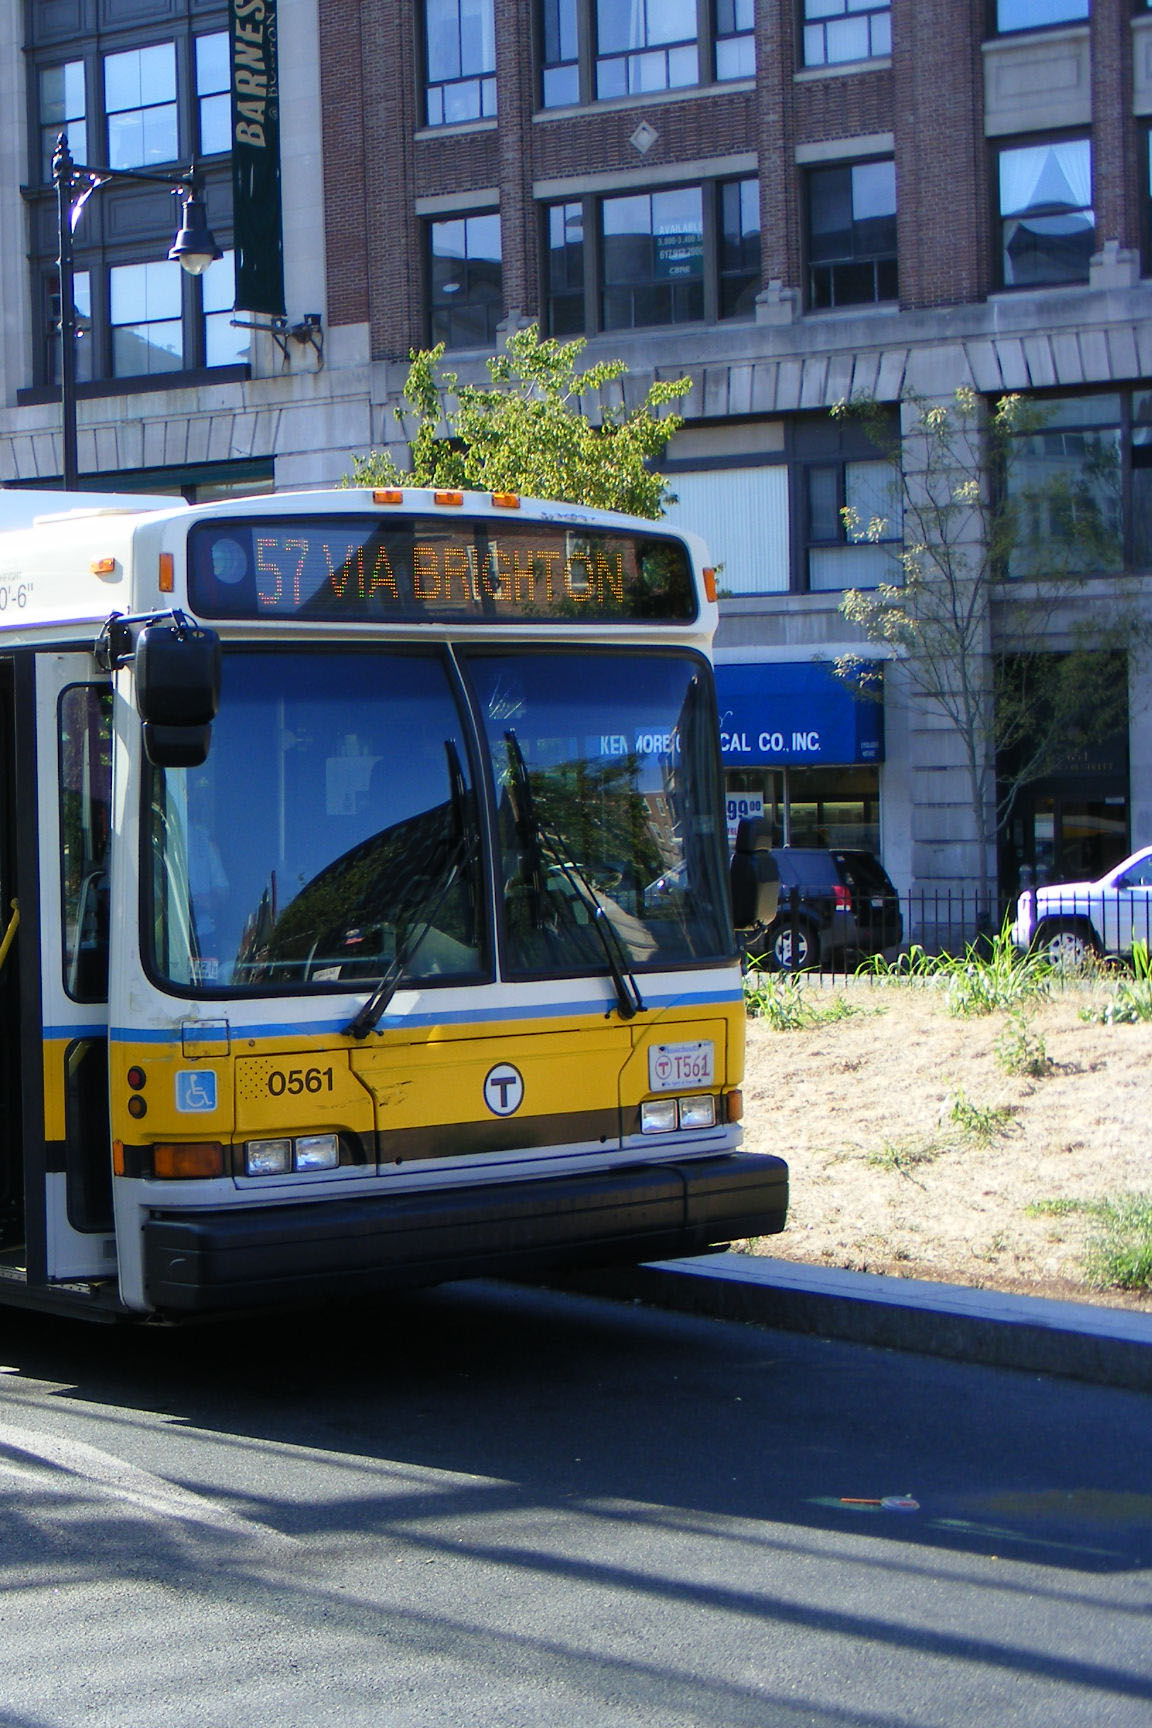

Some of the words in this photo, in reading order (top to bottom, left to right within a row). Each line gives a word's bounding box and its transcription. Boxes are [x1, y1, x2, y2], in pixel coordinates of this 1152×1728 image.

[267, 13, 278, 97] BOTON
[257, 539, 310, 605] 57
[322, 544, 399, 599] VIA
[413, 546, 623, 603] BRIGHTON
[268, 1067, 335, 1096] 0561
[674, 1054, 710, 1080] T561
[490, 1076, 517, 1108] T
